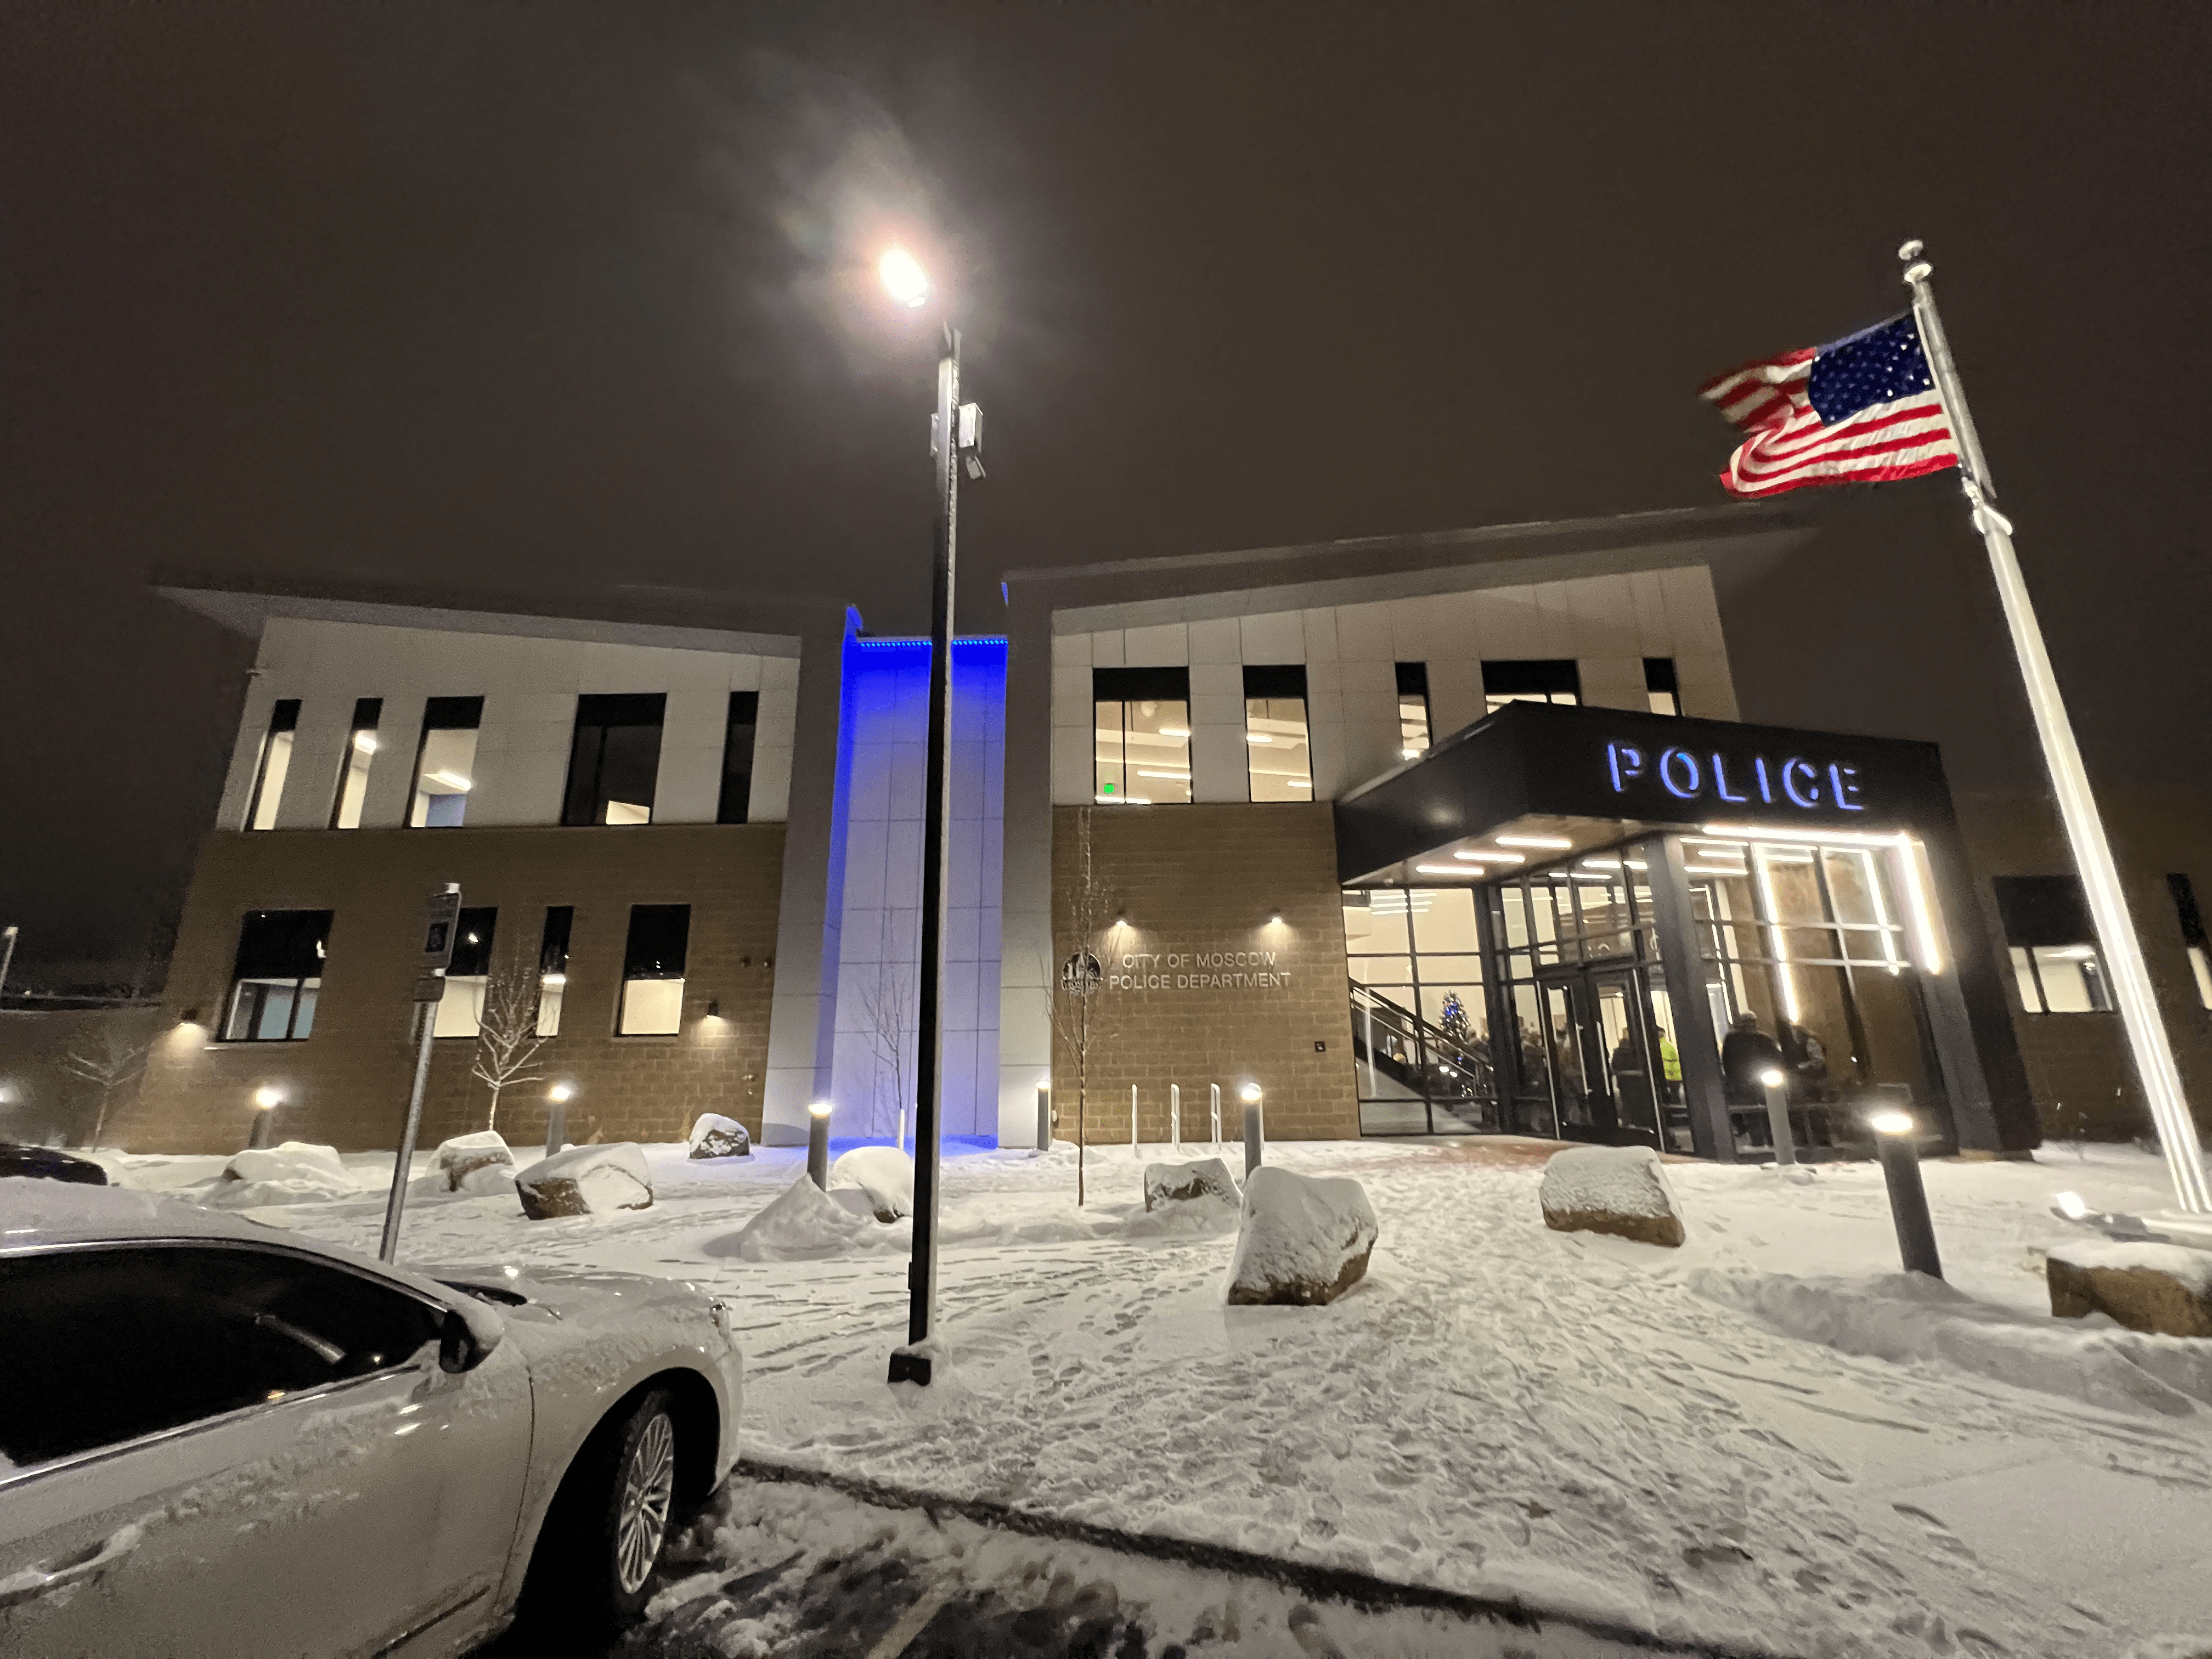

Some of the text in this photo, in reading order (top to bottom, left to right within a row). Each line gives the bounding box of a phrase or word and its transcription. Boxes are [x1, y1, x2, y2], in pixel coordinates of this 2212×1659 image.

[1607, 743, 1864, 811] POLICE
[1122, 951, 1276, 968] CITY OF MOSCOW
[1109, 975, 1170, 989] POLICE
[1177, 972, 1291, 989] DEPARTMENT
